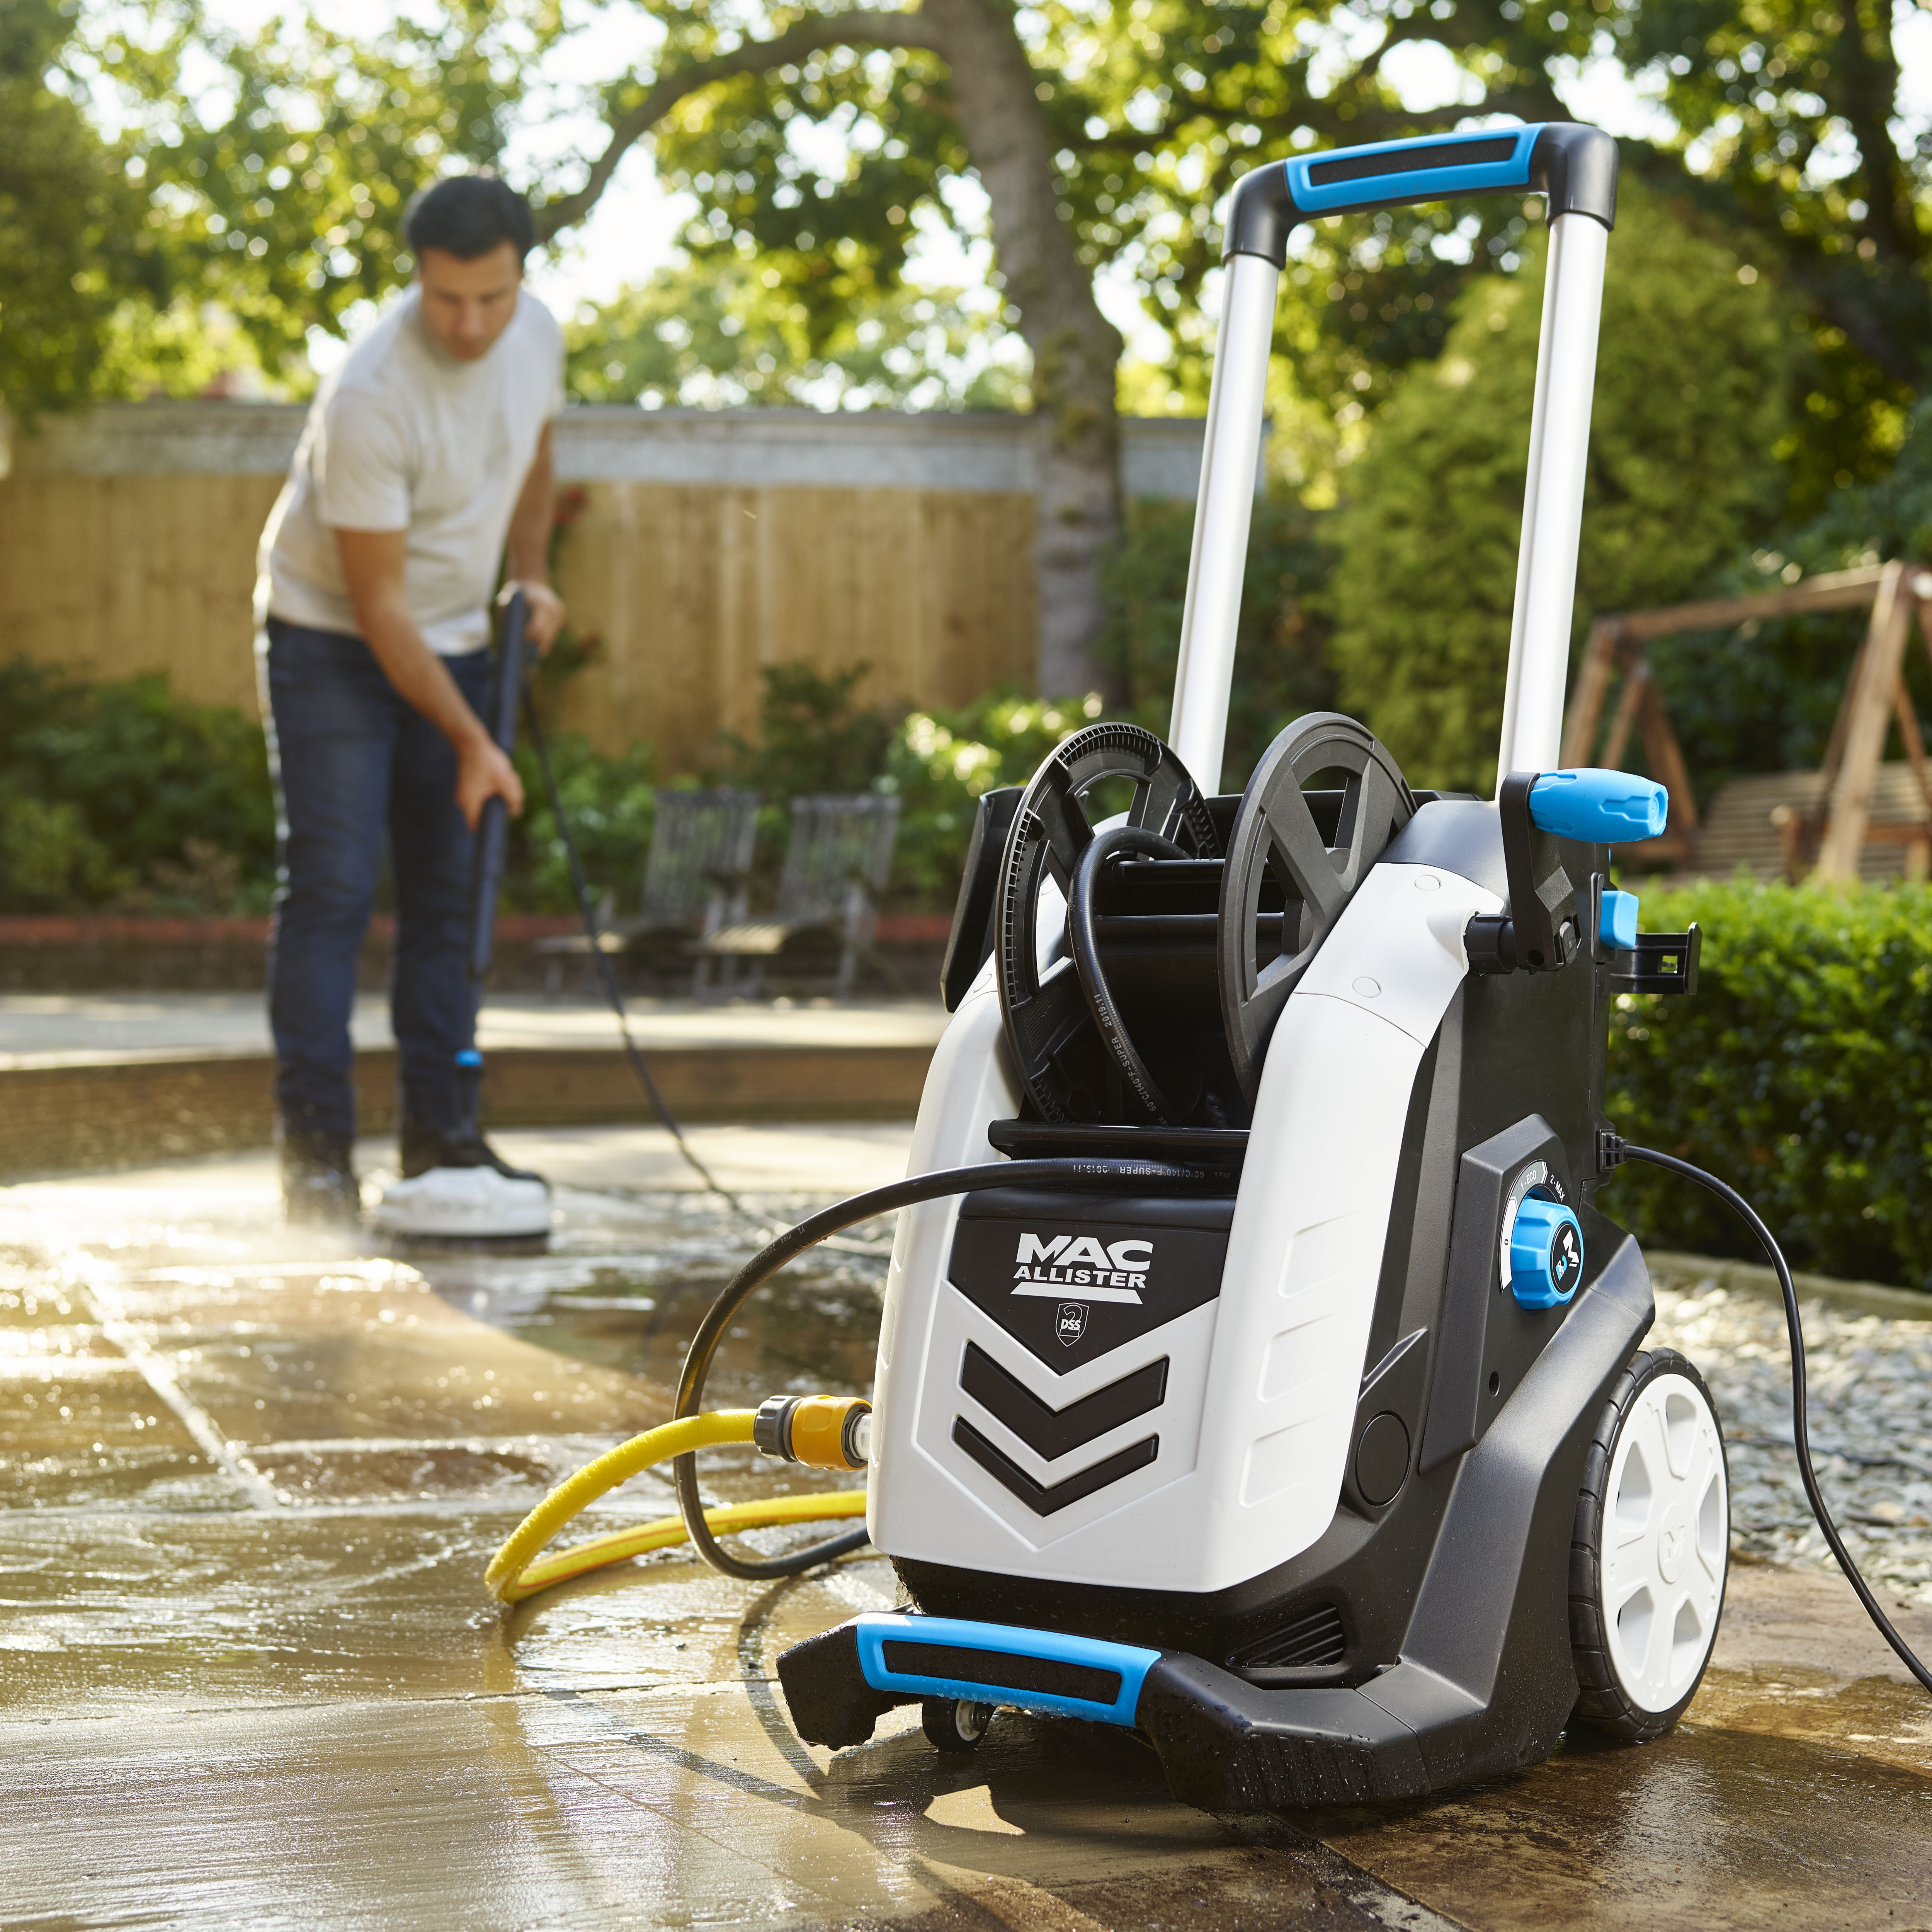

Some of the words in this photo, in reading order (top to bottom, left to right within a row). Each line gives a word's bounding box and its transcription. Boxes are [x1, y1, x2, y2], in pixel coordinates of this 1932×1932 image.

[1093, 993, 1112, 1027] 2019.11
[1158, 1116, 1168, 1126] ax
[1016, 1233, 1153, 1271] MAC
[1013, 1265, 1146, 1288] ALLISTER
[1061, 1319, 1081, 1330] DSS
